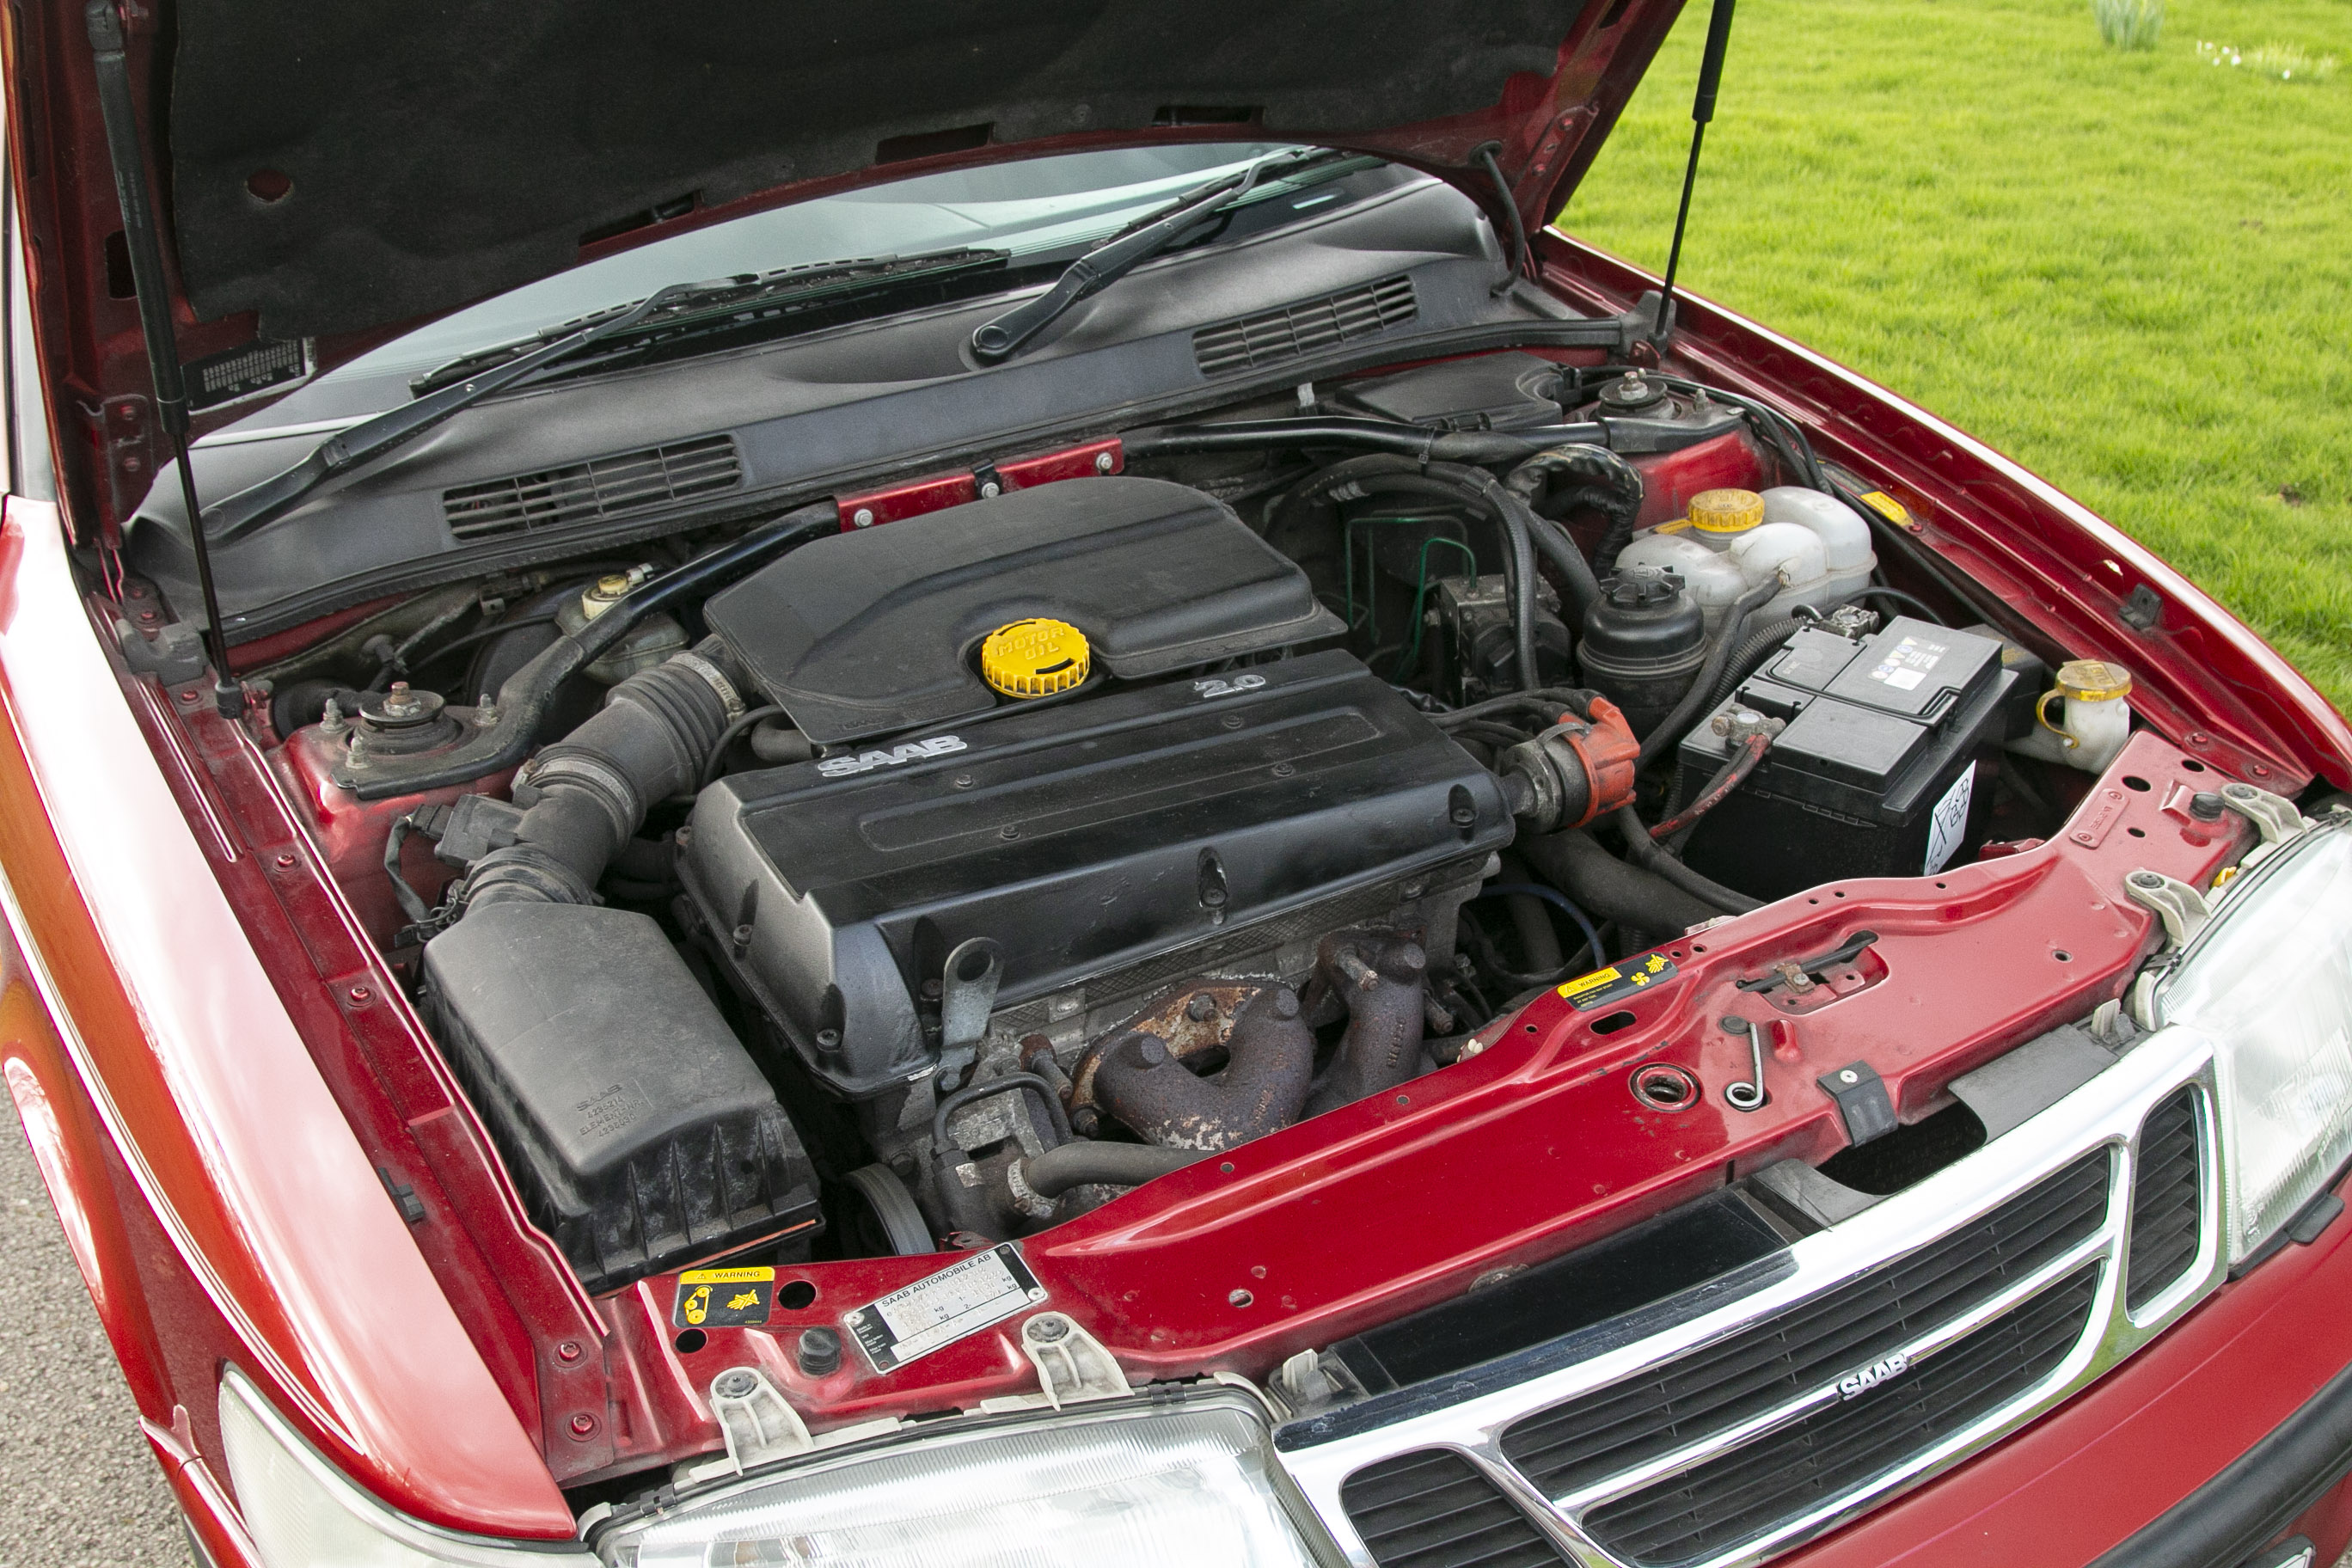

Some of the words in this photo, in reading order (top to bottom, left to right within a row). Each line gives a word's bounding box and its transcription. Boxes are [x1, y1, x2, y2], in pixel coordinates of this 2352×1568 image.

[997, 627, 1064, 657] MOTOR
[1025, 641, 1059, 660] OIL
[1194, 674, 1266, 698] 2.0
[818, 735, 968, 777] SAAB
[1577, 972, 1611, 987] WARNING
[882, 1290, 911, 1308] SAAB
[913, 1261, 976, 1293] AUTOMOBILE
[977, 1253, 991, 1265] AB
[1839, 1353, 1908, 1401] SAAB
